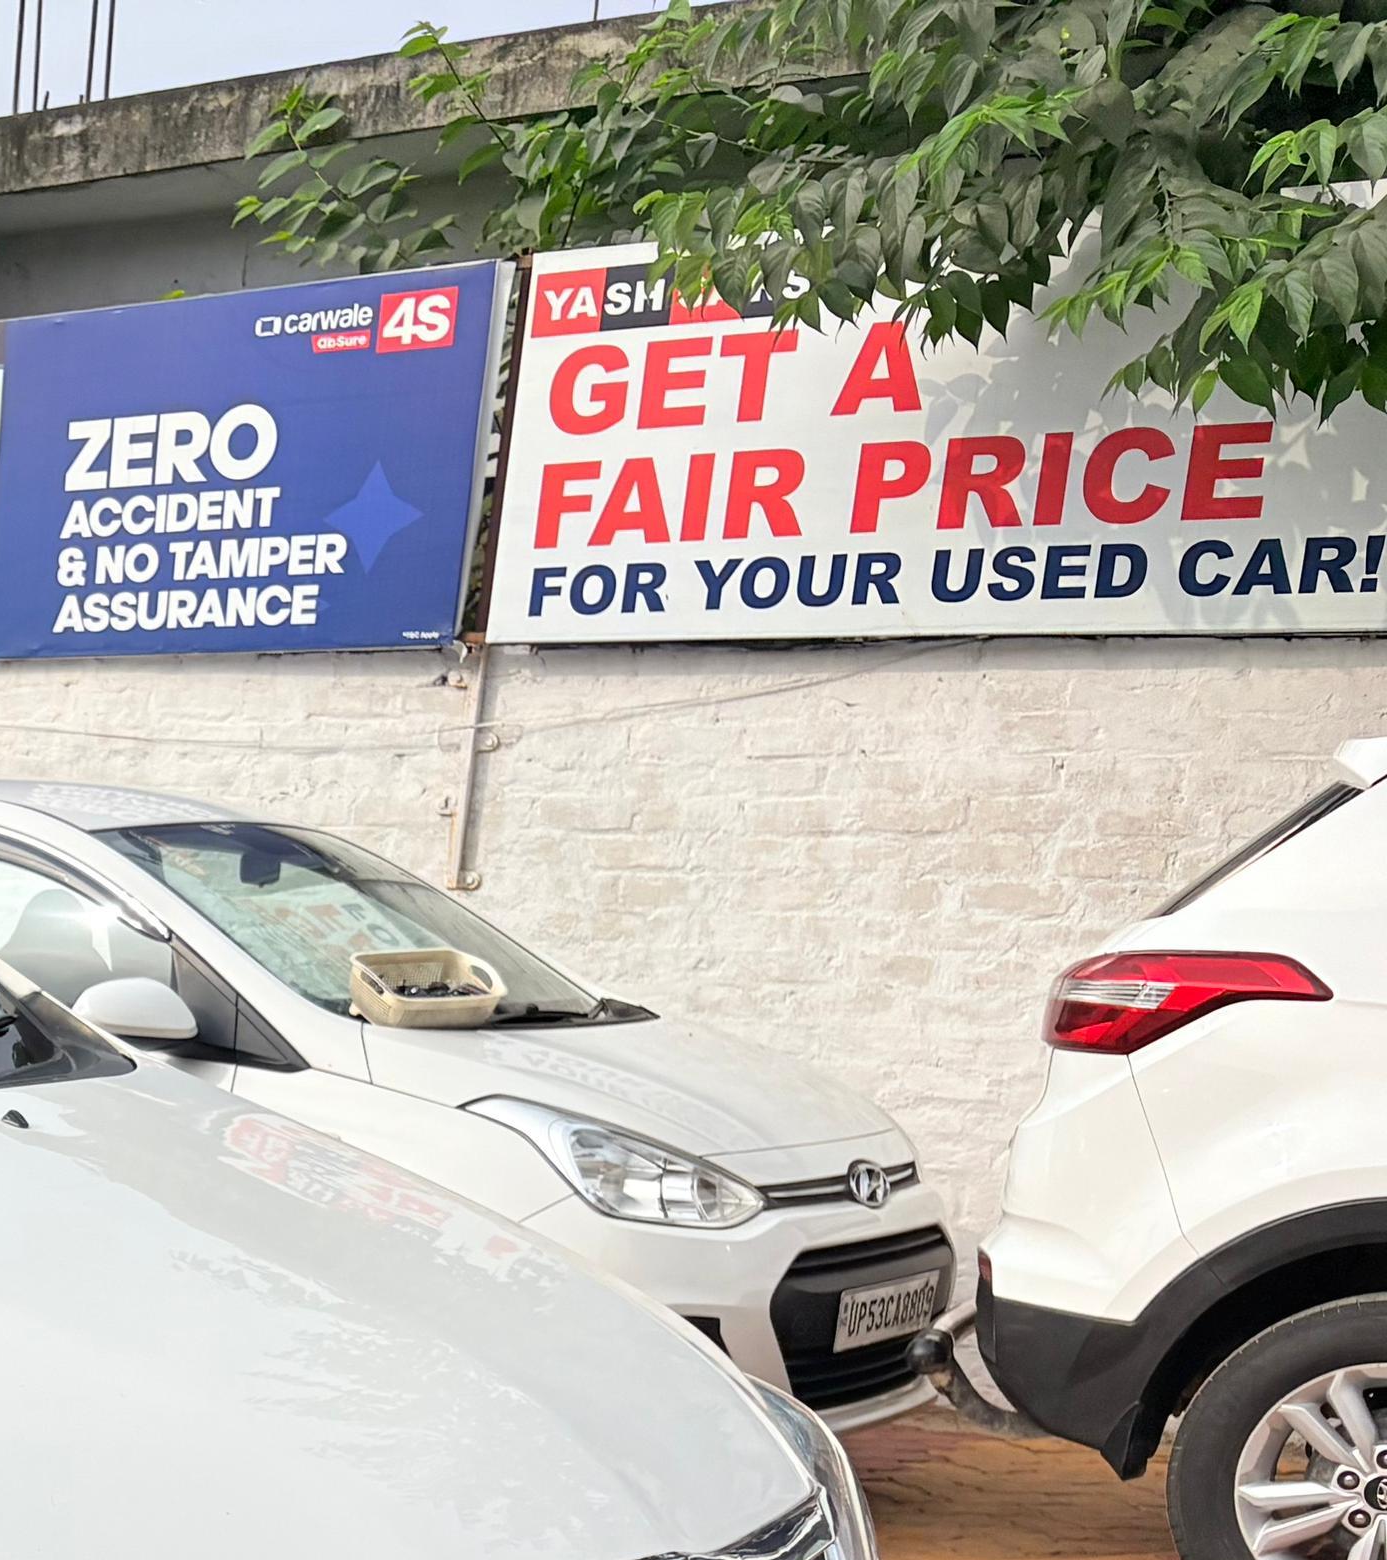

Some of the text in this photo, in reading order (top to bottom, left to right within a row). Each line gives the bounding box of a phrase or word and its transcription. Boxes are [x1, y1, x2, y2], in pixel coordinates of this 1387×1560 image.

[284, 303, 374, 335] carwale
[382, 294, 451, 345] 4S
[544, 279, 667, 321] YASH
[549, 321, 922, 436] GET A
[64, 404, 278, 492] ZERO
[533, 421, 1274, 549] FAIR PRICE
[60, 486, 280, 539] ACCIDENT
[56, 533, 348, 588] & NO TAMPER
[528, 535, 1386, 617] FOR YOUR USED CAR!
[52, 584, 320, 634] ASSURANCE
